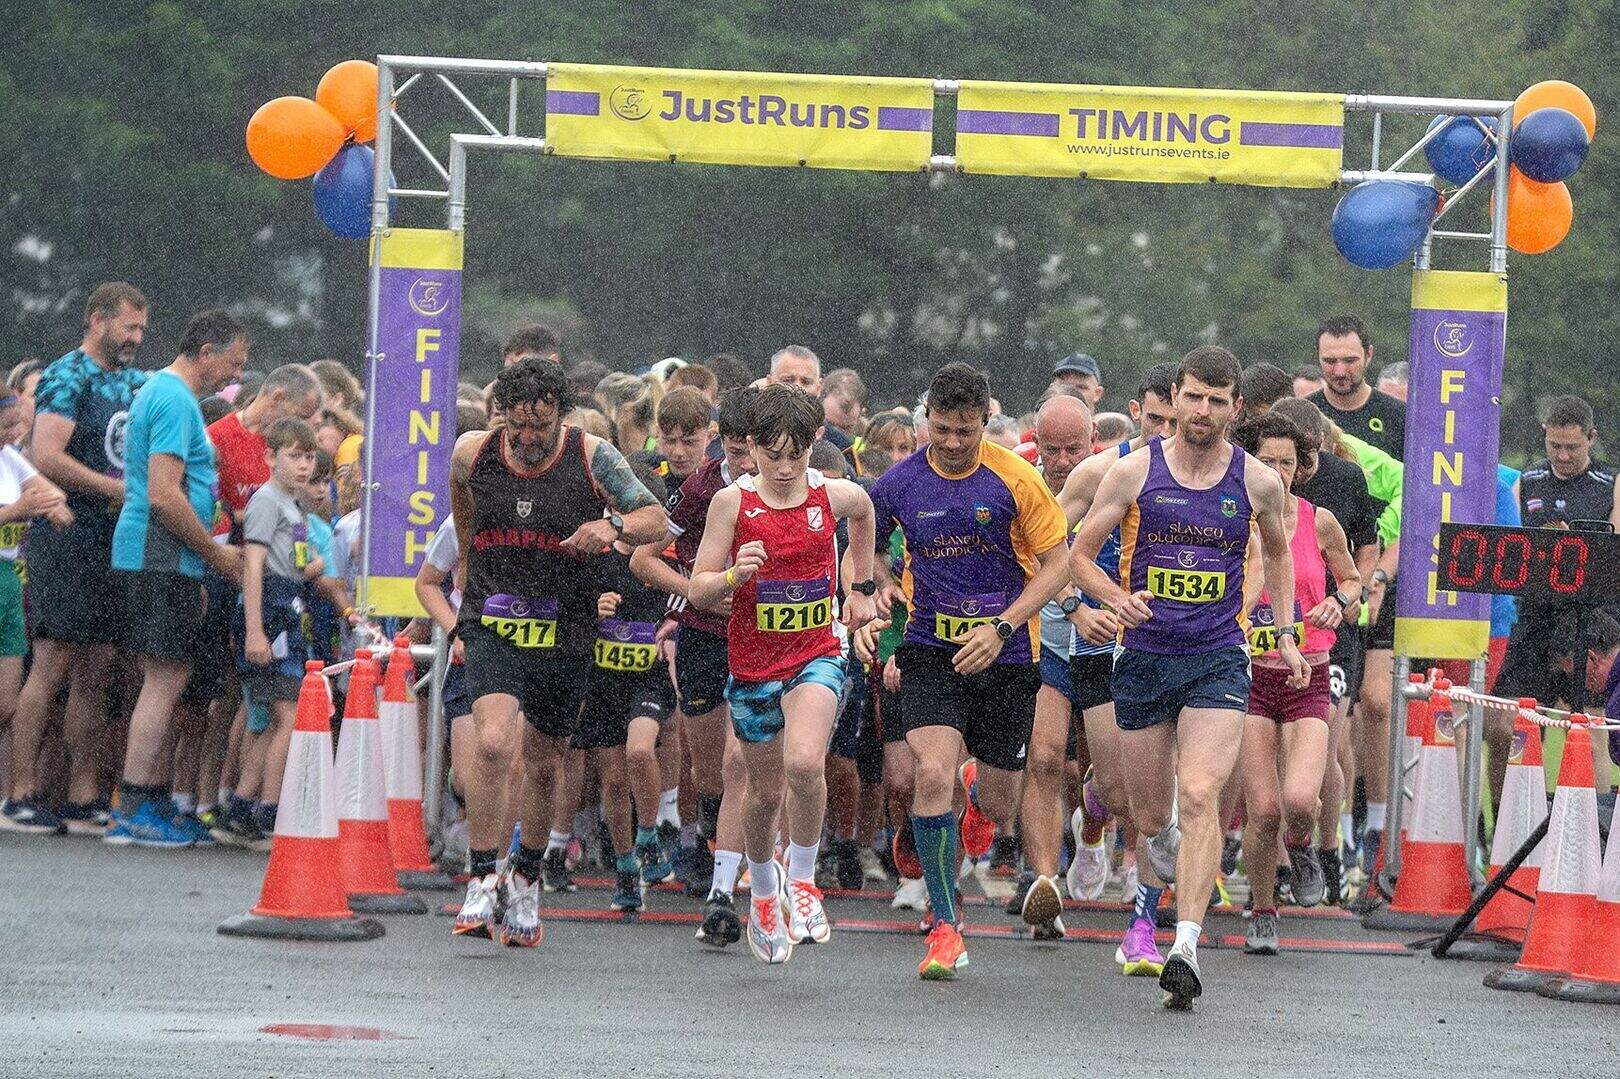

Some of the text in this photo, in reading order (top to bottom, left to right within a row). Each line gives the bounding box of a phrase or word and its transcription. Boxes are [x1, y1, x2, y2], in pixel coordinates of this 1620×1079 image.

[660, 90, 870, 129] JustRuns
[1068, 107, 1232, 145] TIMING
[1067, 143, 1231, 161] www.justrunsevents.ie
[404, 328, 442, 565] FINISH
[1427, 370, 1466, 605] FINIH
[919, 546, 975, 559] LYMPIC
[1154, 571, 1220, 599] 1534
[763, 602, 827, 630] 1210
[940, 618, 986, 640] 14
[488, 621, 552, 646] 1217
[596, 642, 652, 668] 1453
